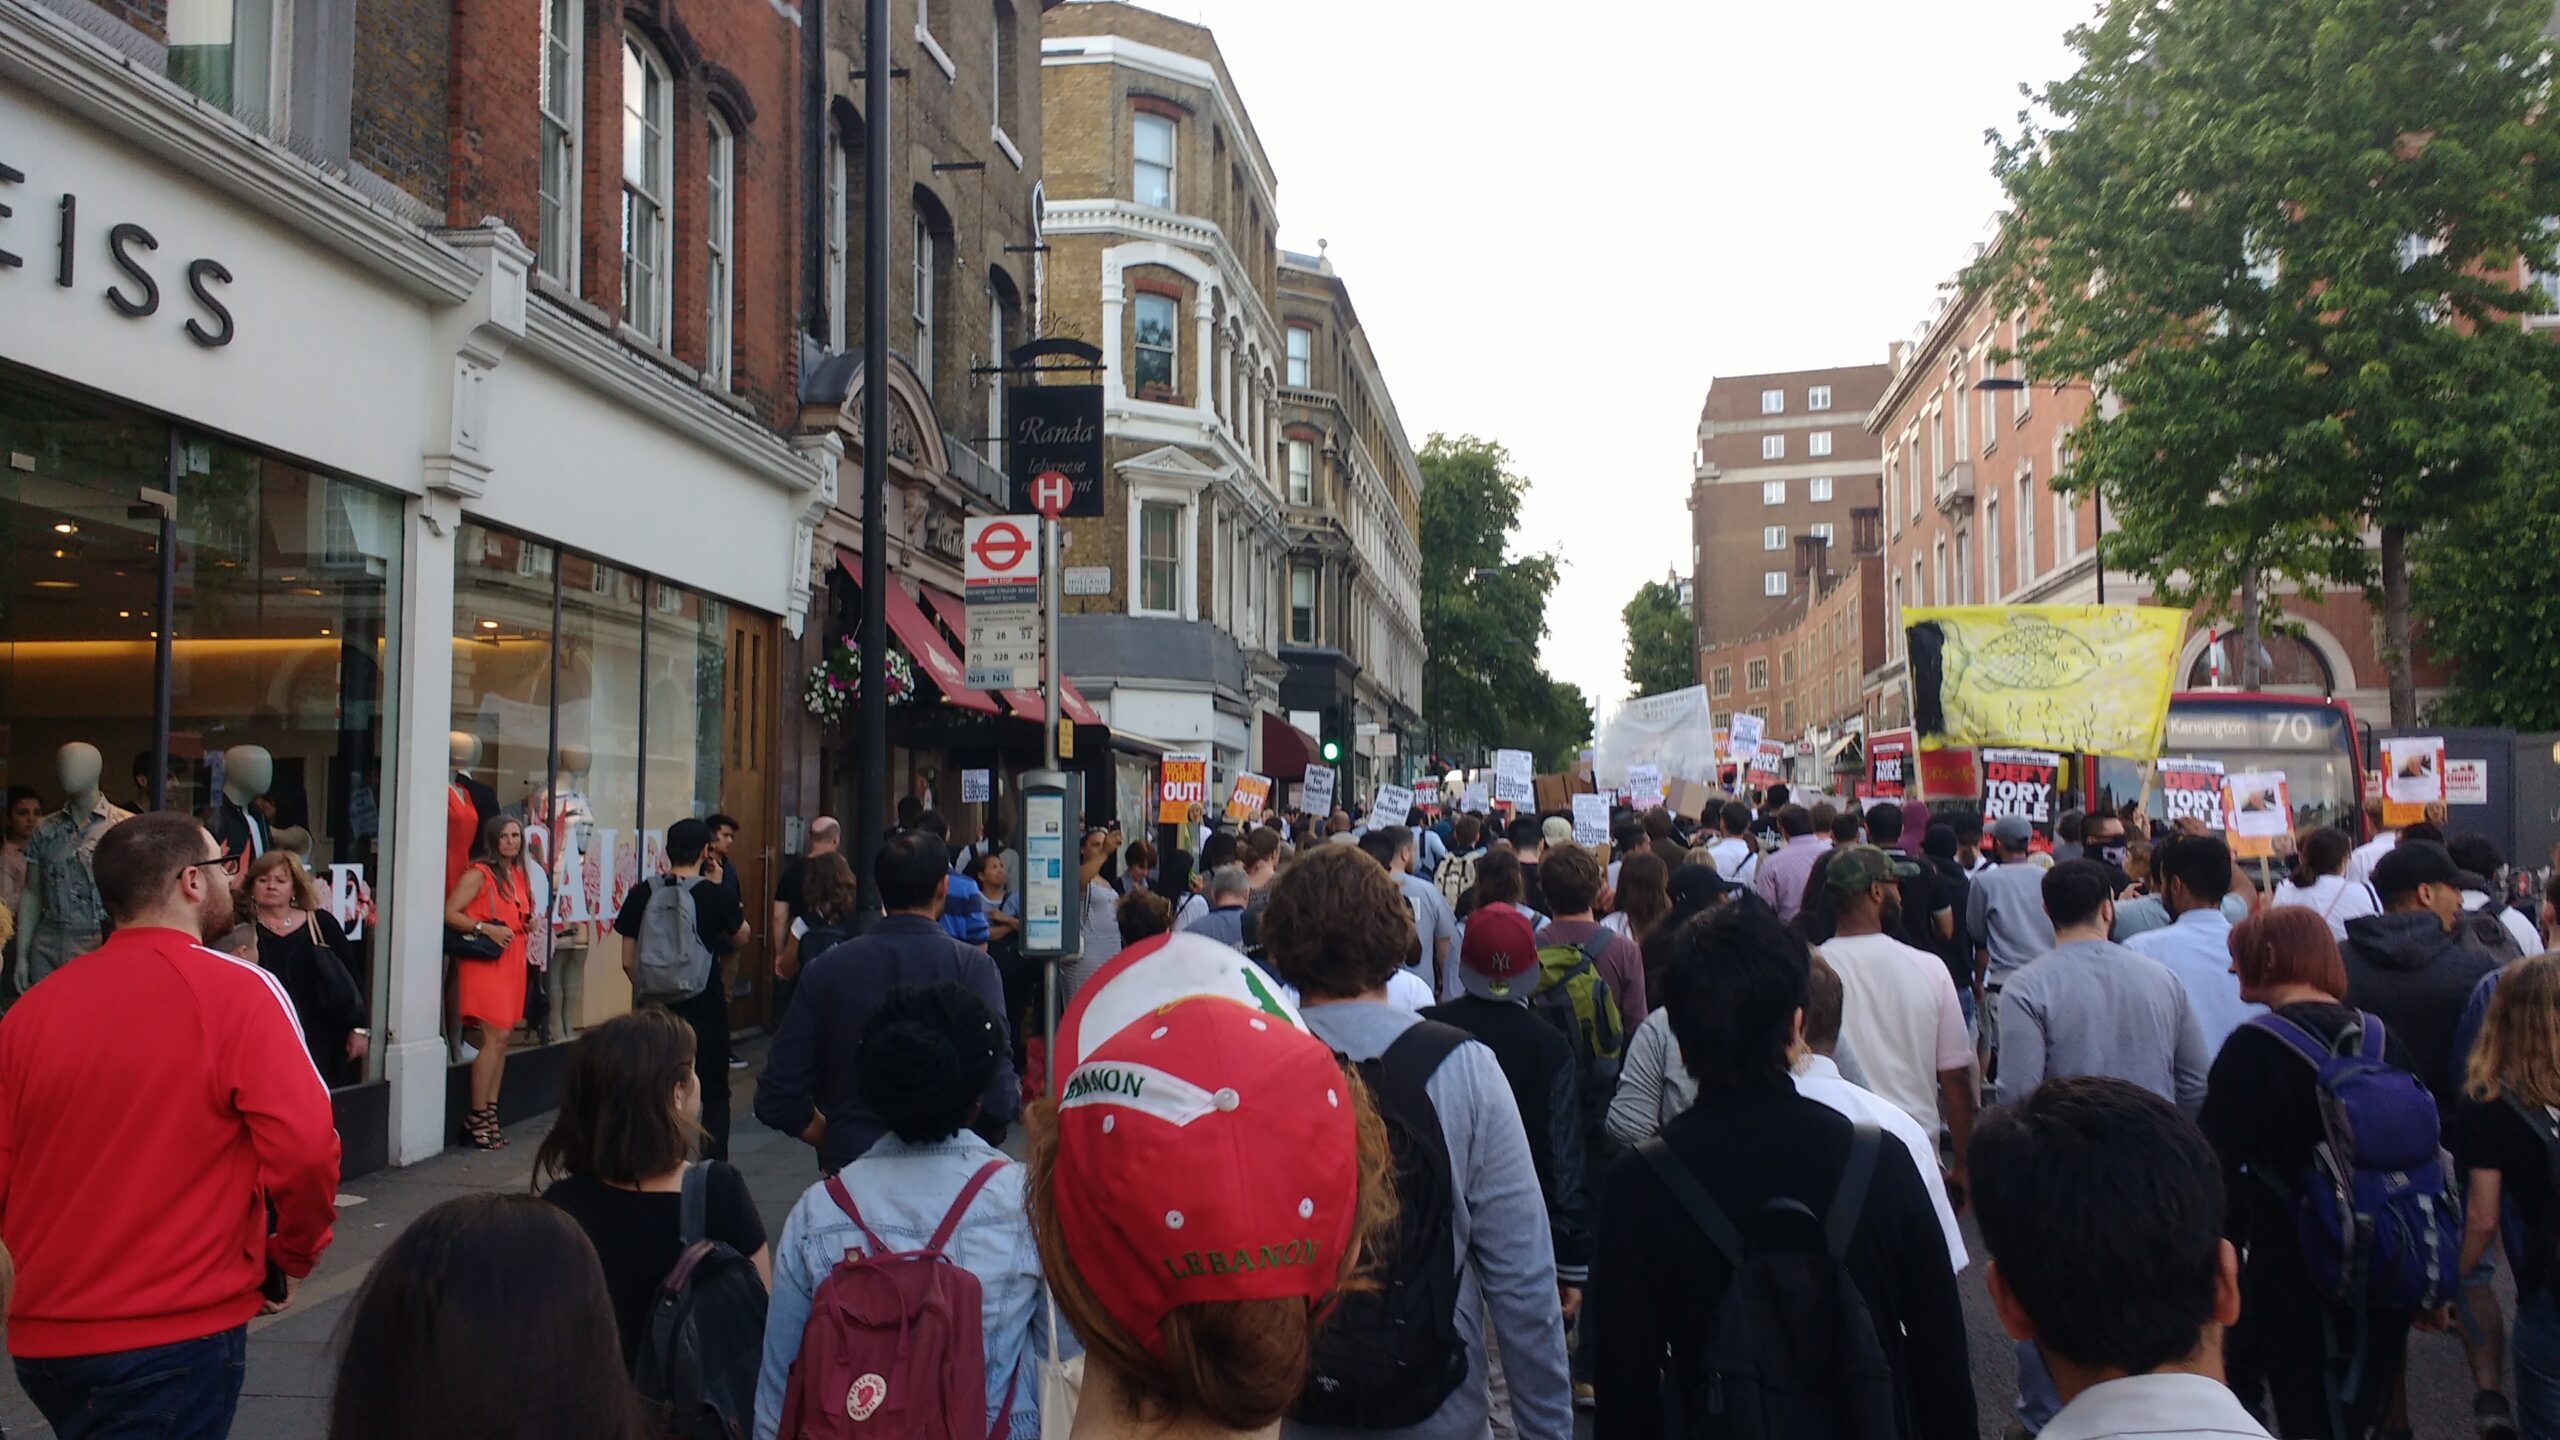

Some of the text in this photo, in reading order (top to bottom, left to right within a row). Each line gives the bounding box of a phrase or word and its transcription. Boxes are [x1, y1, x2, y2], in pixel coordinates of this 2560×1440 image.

[1018, 416, 1095, 445] Randa
[1038, 478, 1063, 509] H
[1000, 576, 1014, 584] STOP
[1018, 586, 1036, 594] Street
[972, 631, 1031, 640] 27 28 52
[972, 651, 1034, 661] 70 328 452
[968, 674, 986, 683] N28
[992, 674, 1010, 683] N31
[2170, 712, 2313, 744] Kensington 70
[1992, 753, 2050, 765] Socialist Worker
[1166, 771, 1202, 782] TORIES
[1309, 766, 1331, 778] Justice
[1988, 763, 2052, 784] DEFY
[1313, 776, 1323, 785] for
[2164, 771, 2221, 792] DEFY
[1163, 782, 1202, 801] OUT!
[1305, 783, 1331, 795] Grenfell
[1384, 785, 1409, 800] Justice
[1986, 779, 2051, 803] TORY
[1233, 789, 1265, 809] OUT!
[2164, 788, 2221, 811] TORY
[1376, 802, 1407, 816] Grenfell
[1985, 798, 2049, 824] RULE
[1163, 1238, 1320, 1280] LEBANON
